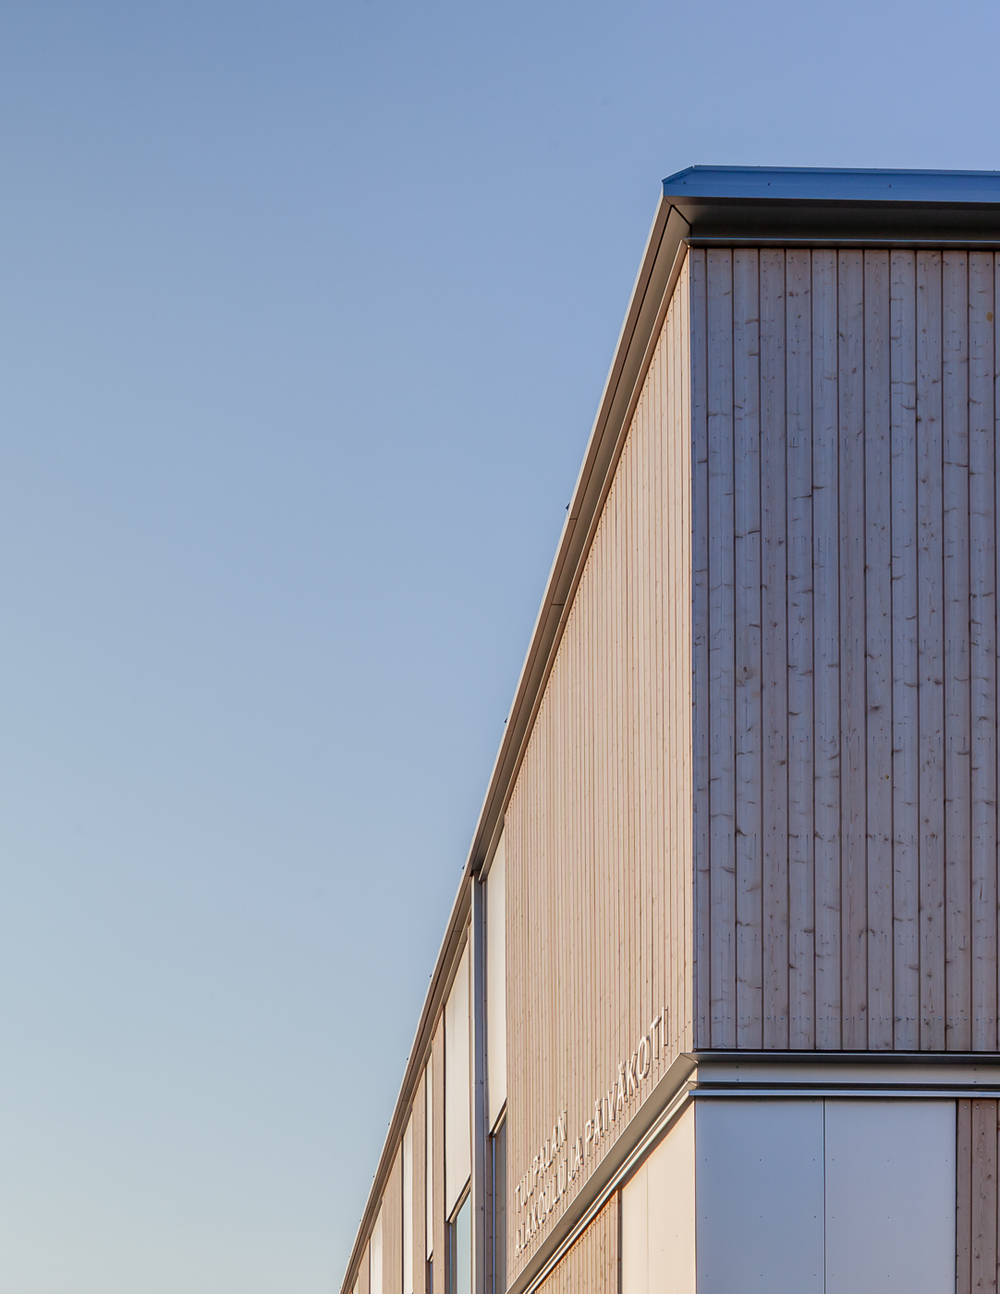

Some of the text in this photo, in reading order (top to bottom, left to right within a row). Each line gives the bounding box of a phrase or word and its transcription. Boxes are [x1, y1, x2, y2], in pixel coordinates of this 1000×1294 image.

[515, 1006, 669, 1259] ALAKOULU JA PÄIVÄKOTI
[515, 1110, 568, 1214] TUUPALAN
